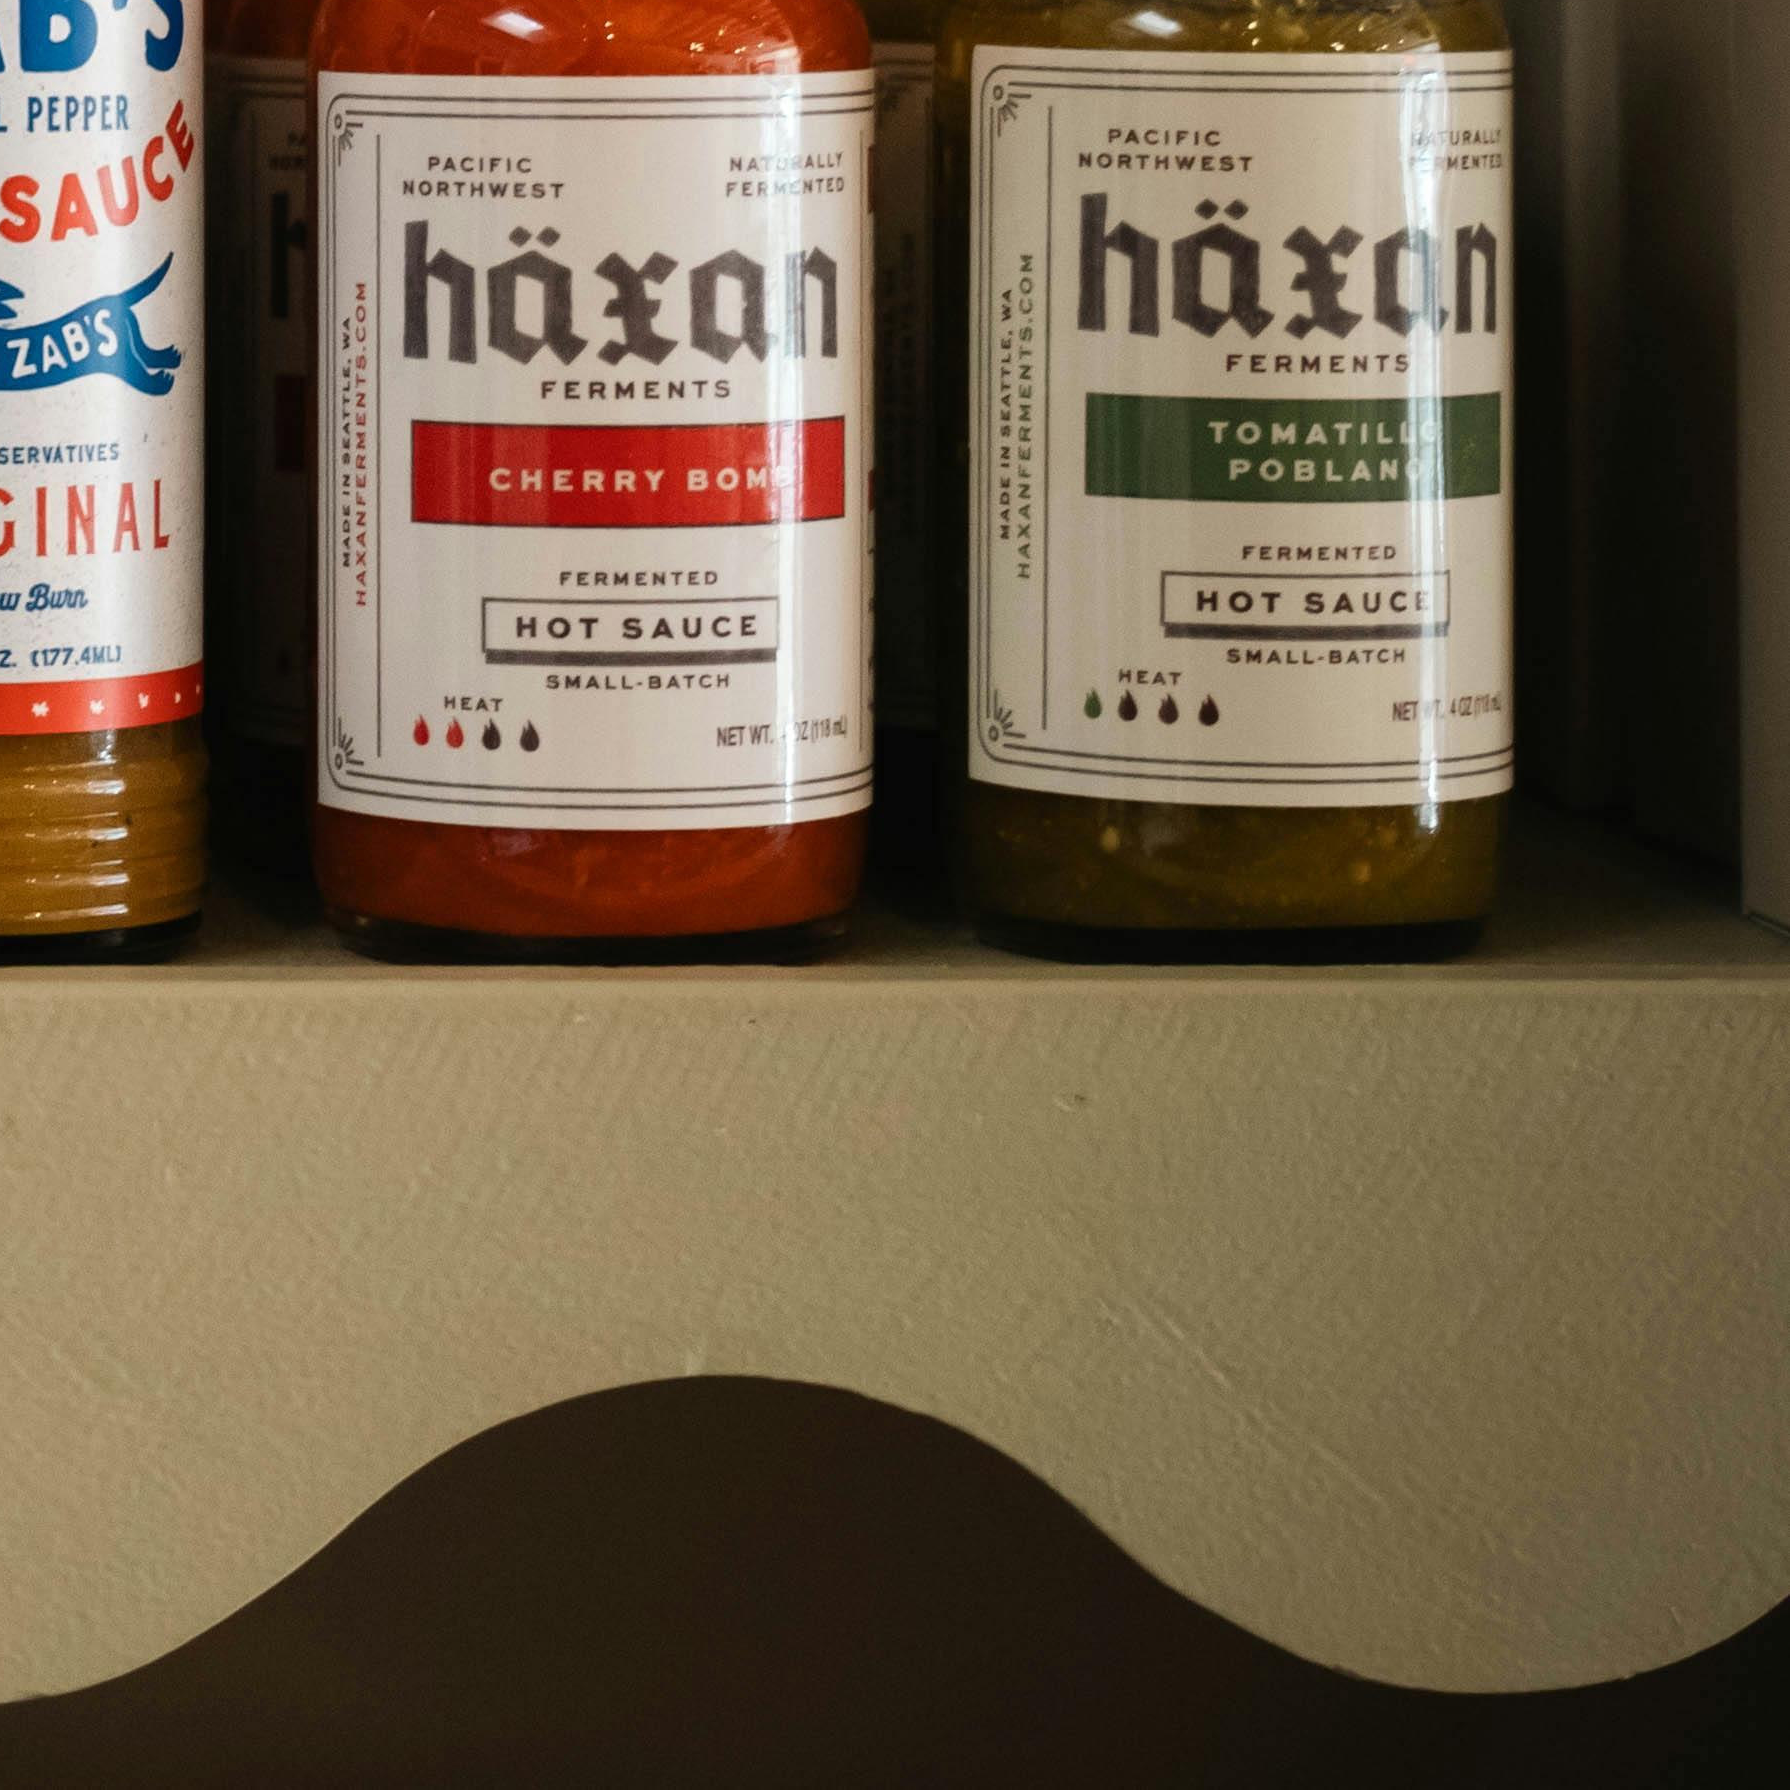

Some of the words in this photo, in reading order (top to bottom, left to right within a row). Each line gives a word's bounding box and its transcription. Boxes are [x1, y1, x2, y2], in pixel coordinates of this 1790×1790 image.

[26, 93, 130, 136] PEPPER
[1107, 128, 1222, 147] PACIFIC
[427, 155, 533, 174] PACIFIC
[729, 152, 844, 173] NATURALLY
[1078, 153, 1254, 173] NORTHWEST
[402, 179, 566, 199] NORTHWEST
[725, 176, 845, 199] FERMENTED
[1077, 192, 1498, 340] häxan
[402, 218, 839, 366] häxan
[1000, 288, 1012, 322] WA
[4, 306, 120, 382] ZAB'S
[341, 317, 352, 350] WA
[1225, 355, 1410, 374] FERMENTS
[540, 379, 733, 400] FERMENTS
[1000, 331, 1013, 438] SEATTLE,
[341, 359, 353, 465] SEATTLE,
[1016, 253, 1033, 580] HAXANFERMENTS.COM
[355, 282, 368, 608] HAXANFERMENTS.COM
[1000, 445, 1012, 469] IN
[341, 473, 352, 496] IN
[489, 467, 665, 493] CHERRY
[686, 466, 792, 492] BOMB
[1000, 476, 1012, 541] MADE
[341, 505, 352, 568] MADE
[1241, 545, 1398, 561] FERMENTED
[558, 570, 719, 588] FERMENTED
[28, 581, 90, 612] Burn
[1195, 591, 1282, 614] HOT
[1304, 590, 1429, 614] SAUCE
[514, 617, 597, 641] HOT
[622, 614, 759, 640] SAUCE
[1226, 649, 1406, 666] SMALL-BATCH
[545, 673, 731, 691] SMALL-BATCH
[1118, 669, 1182, 686] HEAT
[443, 695, 503, 713] HEAT
[1392, 700, 1419, 722] NET
[716, 725, 746, 748] NET
[749, 723, 775, 745] WT.
